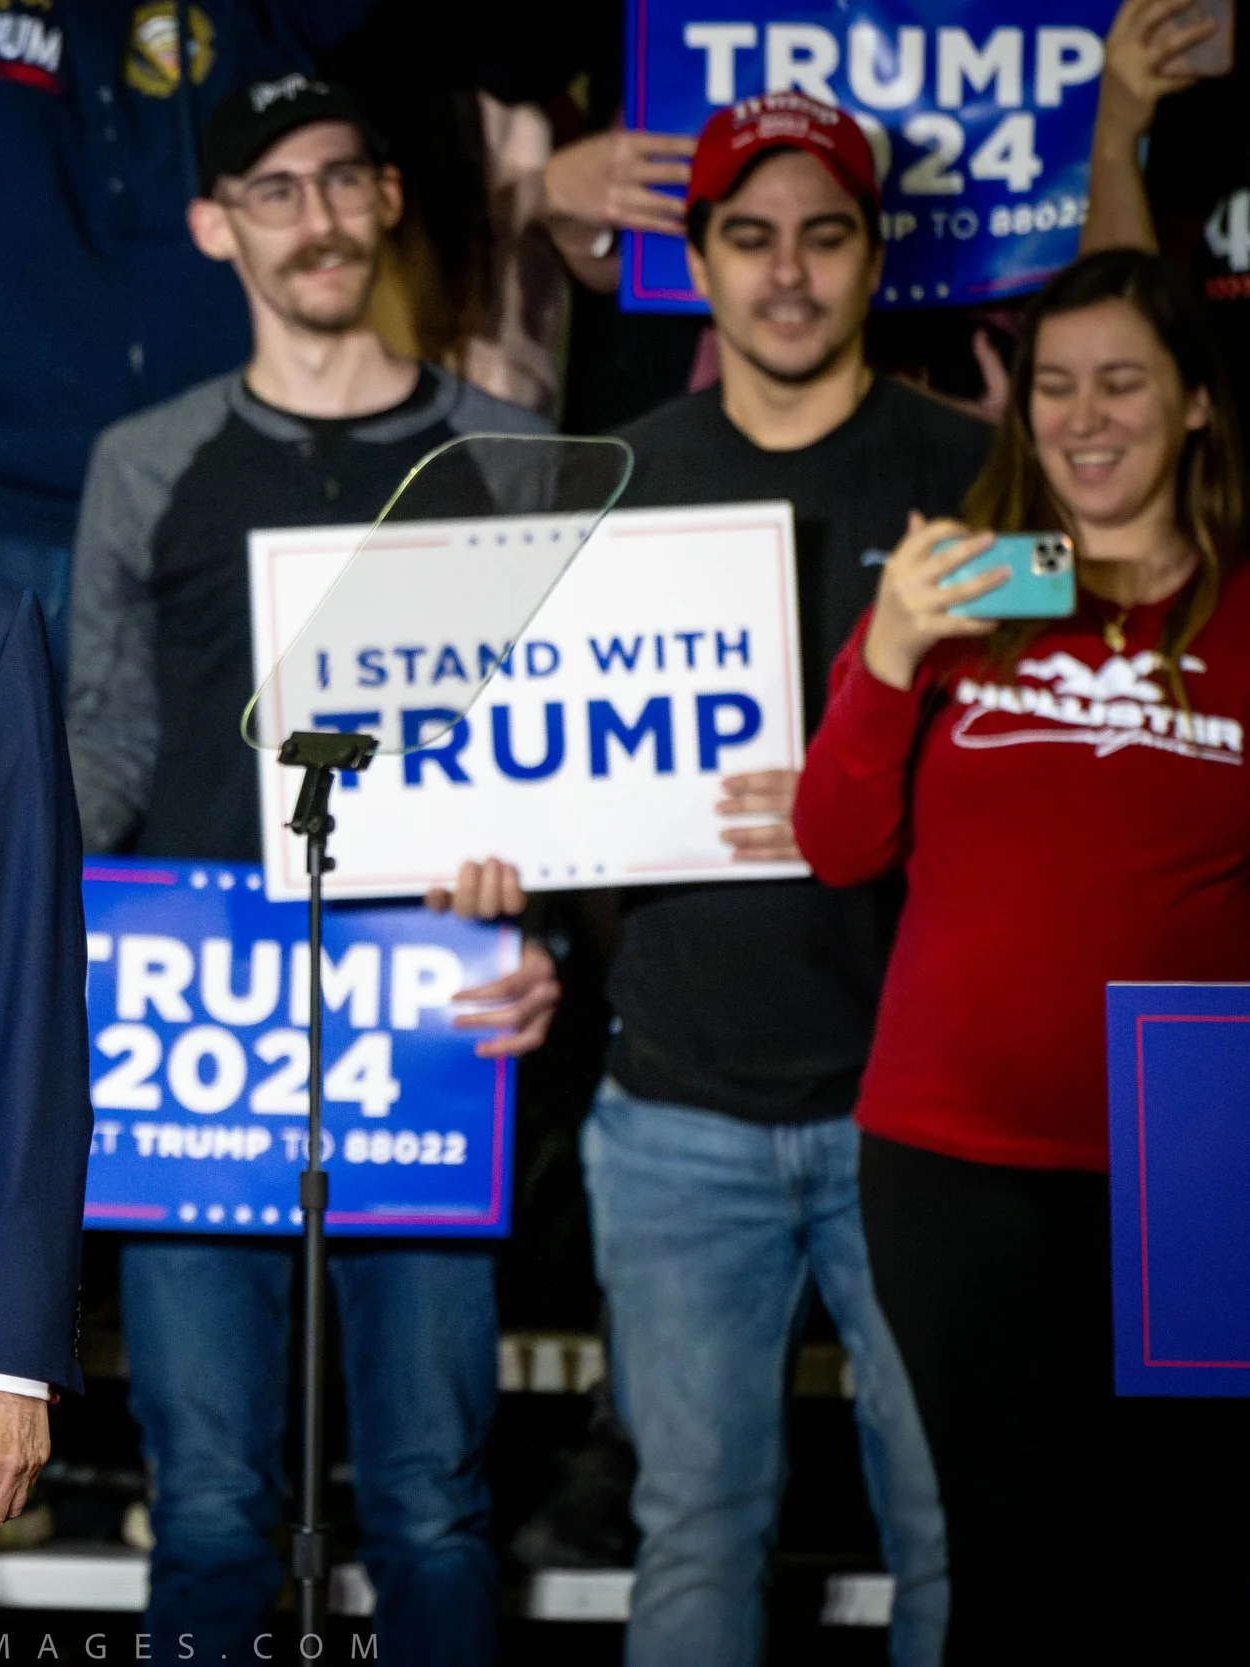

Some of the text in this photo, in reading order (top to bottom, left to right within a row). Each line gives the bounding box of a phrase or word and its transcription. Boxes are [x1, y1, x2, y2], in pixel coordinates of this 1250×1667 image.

[683, 22, 1106, 110] TRUMP
[854, 112, 1043, 194] 24
[932, 208, 979, 240] TO
[316, 628, 752, 690] I STAND WITH
[311, 690, 765, 792] TRUMP
[92, 1022, 401, 1118] 2024
[132, 1122, 273, 1161] TRUMP
[283, 1126, 334, 1164] TO
[344, 1129, 468, 1165] 88022
